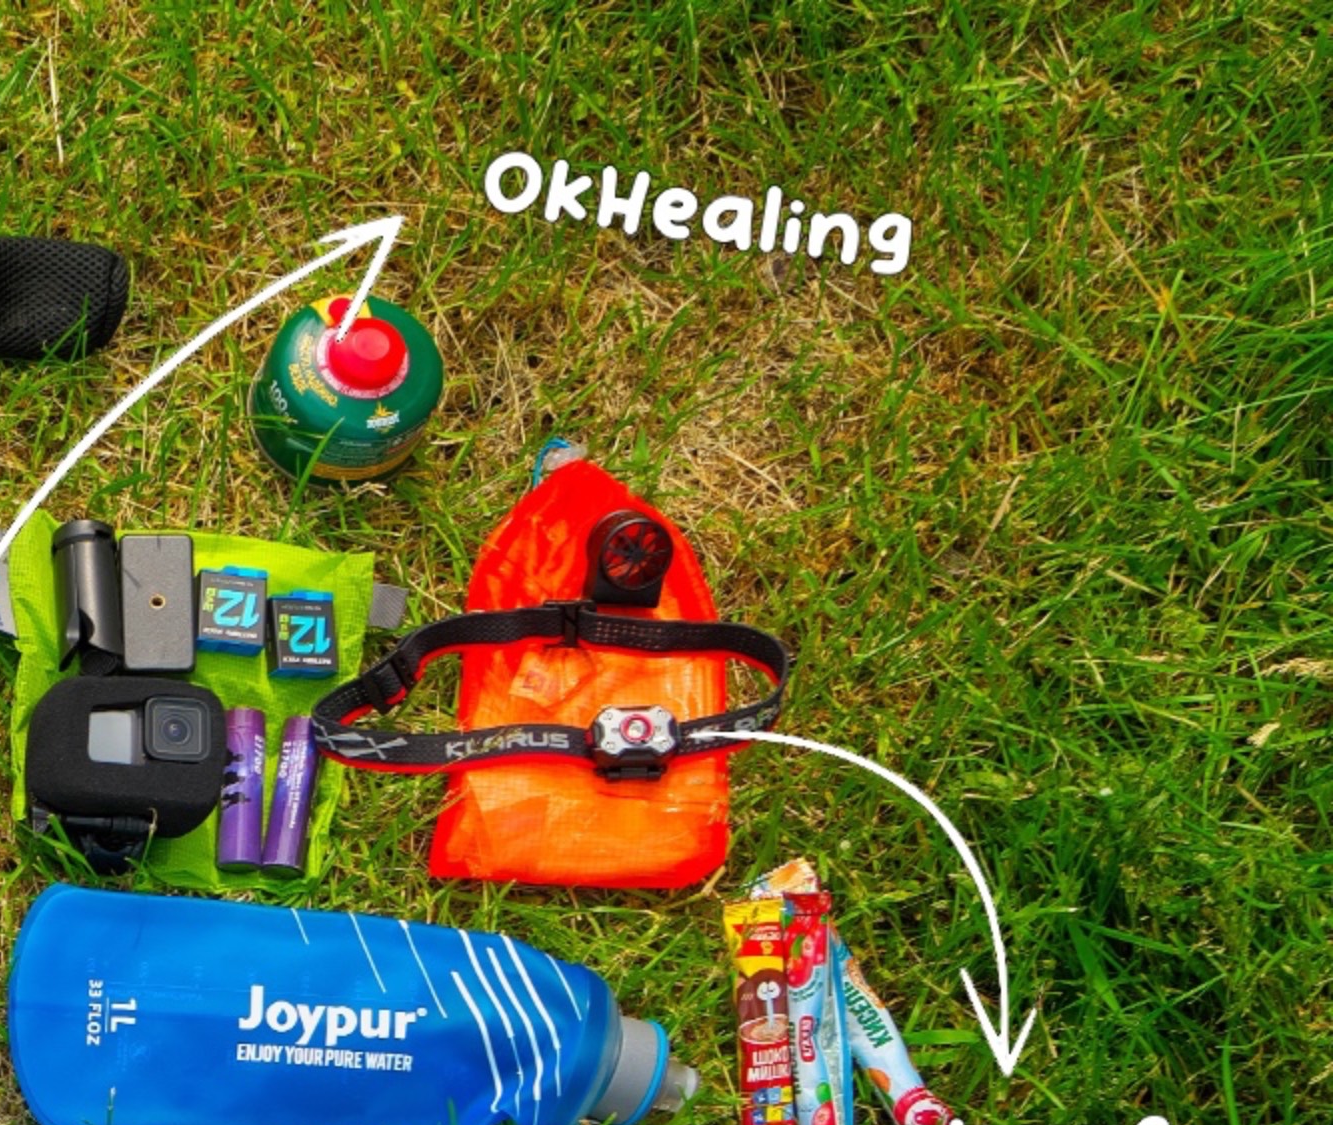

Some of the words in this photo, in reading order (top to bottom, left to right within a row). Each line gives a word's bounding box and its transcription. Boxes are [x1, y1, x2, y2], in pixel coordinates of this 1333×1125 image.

[213, 588, 260, 628] 12
[288, 615, 331, 654] 12
[445, 732, 570, 760] KLARUS
[88, 979, 104, 997] 33
[110, 998, 137, 1033] 1L
[238, 985, 417, 1046] Joypur
[237, 1043, 283, 1062] ENJOY
[285, 1046, 323, 1066] YOUR
[325, 1049, 362, 1069] PURE
[365, 1052, 413, 1072] WATER
